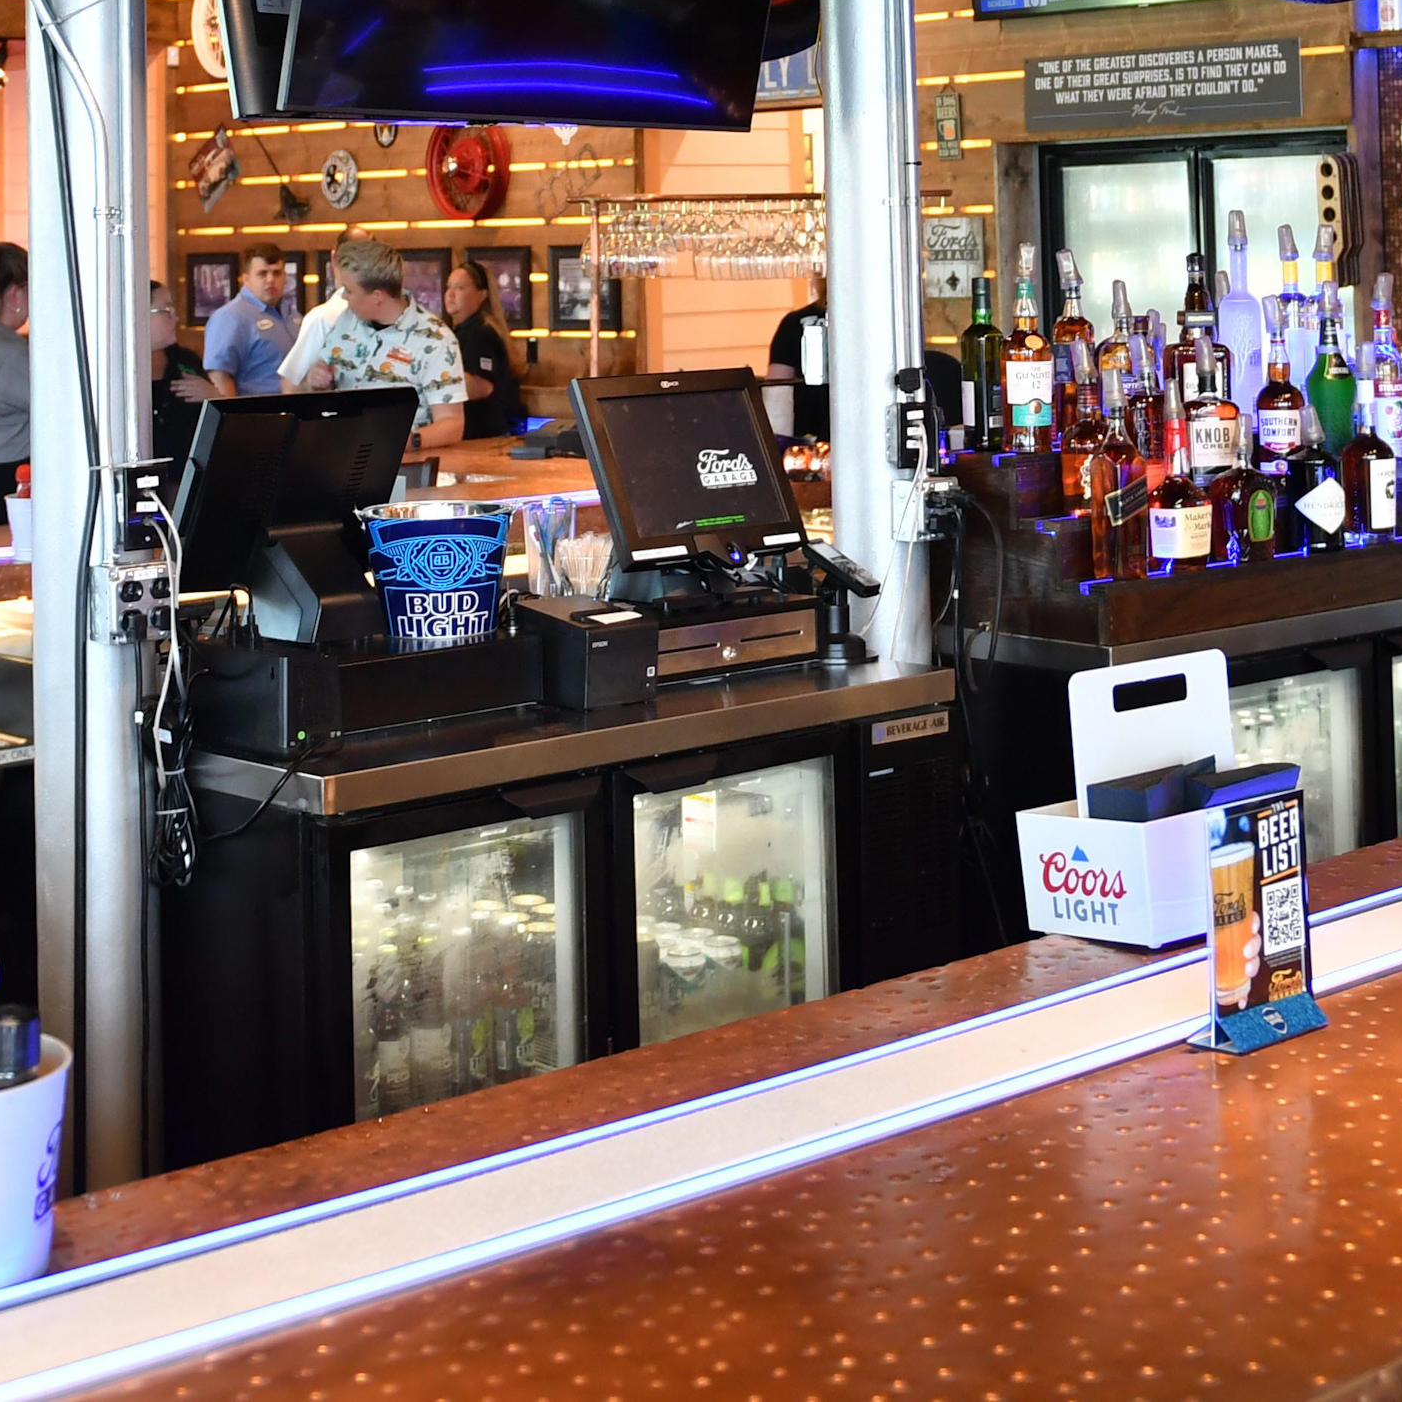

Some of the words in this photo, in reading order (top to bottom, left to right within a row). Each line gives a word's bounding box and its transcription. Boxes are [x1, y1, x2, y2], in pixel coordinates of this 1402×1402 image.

[1062, 60, 1073, 73] OF
[1076, 58, 1092, 72] THE
[1094, 55, 1136, 71] GREATEST
[1138, 50, 1195, 67] DISCOVERIES
[1197, 50, 1205, 63] A
[1206, 47, 1243, 63] PERSON
[1245, 44, 1283, 60] MAKES,
[1035, 76, 1052, 90] ONE
[1054, 75, 1066, 89] OF
[1067, 74, 1091, 88] THEIR
[1093, 72, 1120, 87] GREAT
[1122, 68, 1174, 84] SURPRISES,
[1175, 67, 1184, 80] IS
[1187, 66, 1199, 80] TO
[1200, 64, 1223, 79] FIND
[1225, 62, 1249, 77] THEY
[1251, 61, 1271, 76] CAN
[1273, 60, 1287, 74] DO
[1055, 90, 1080, 104] WHAT
[1082, 88, 1105, 103] THEY
[1107, 86, 1132, 101] WERE
[1134, 84, 1167, 100] AFRAID
[1169, 82, 1192, 97] THEY
[1194, 79, 1240, 96] COULDN'T
[1195, 427, 1231, 444] KNOB
[1260, 417, 1298, 427] SOUTHERN
[1262, 427, 1296, 437] COMFORT
[697, 449, 753, 473] Ford's
[702, 471, 756, 484] GARAGE
[404, 591, 479, 617] BUD
[397, 611, 489, 639] LIGHT
[1257, 807, 1300, 849] BEER
[1261, 838, 1299, 878] LIST
[1039, 852, 1127, 900] Coors
[1052, 896, 1119, 926] LIGHT
